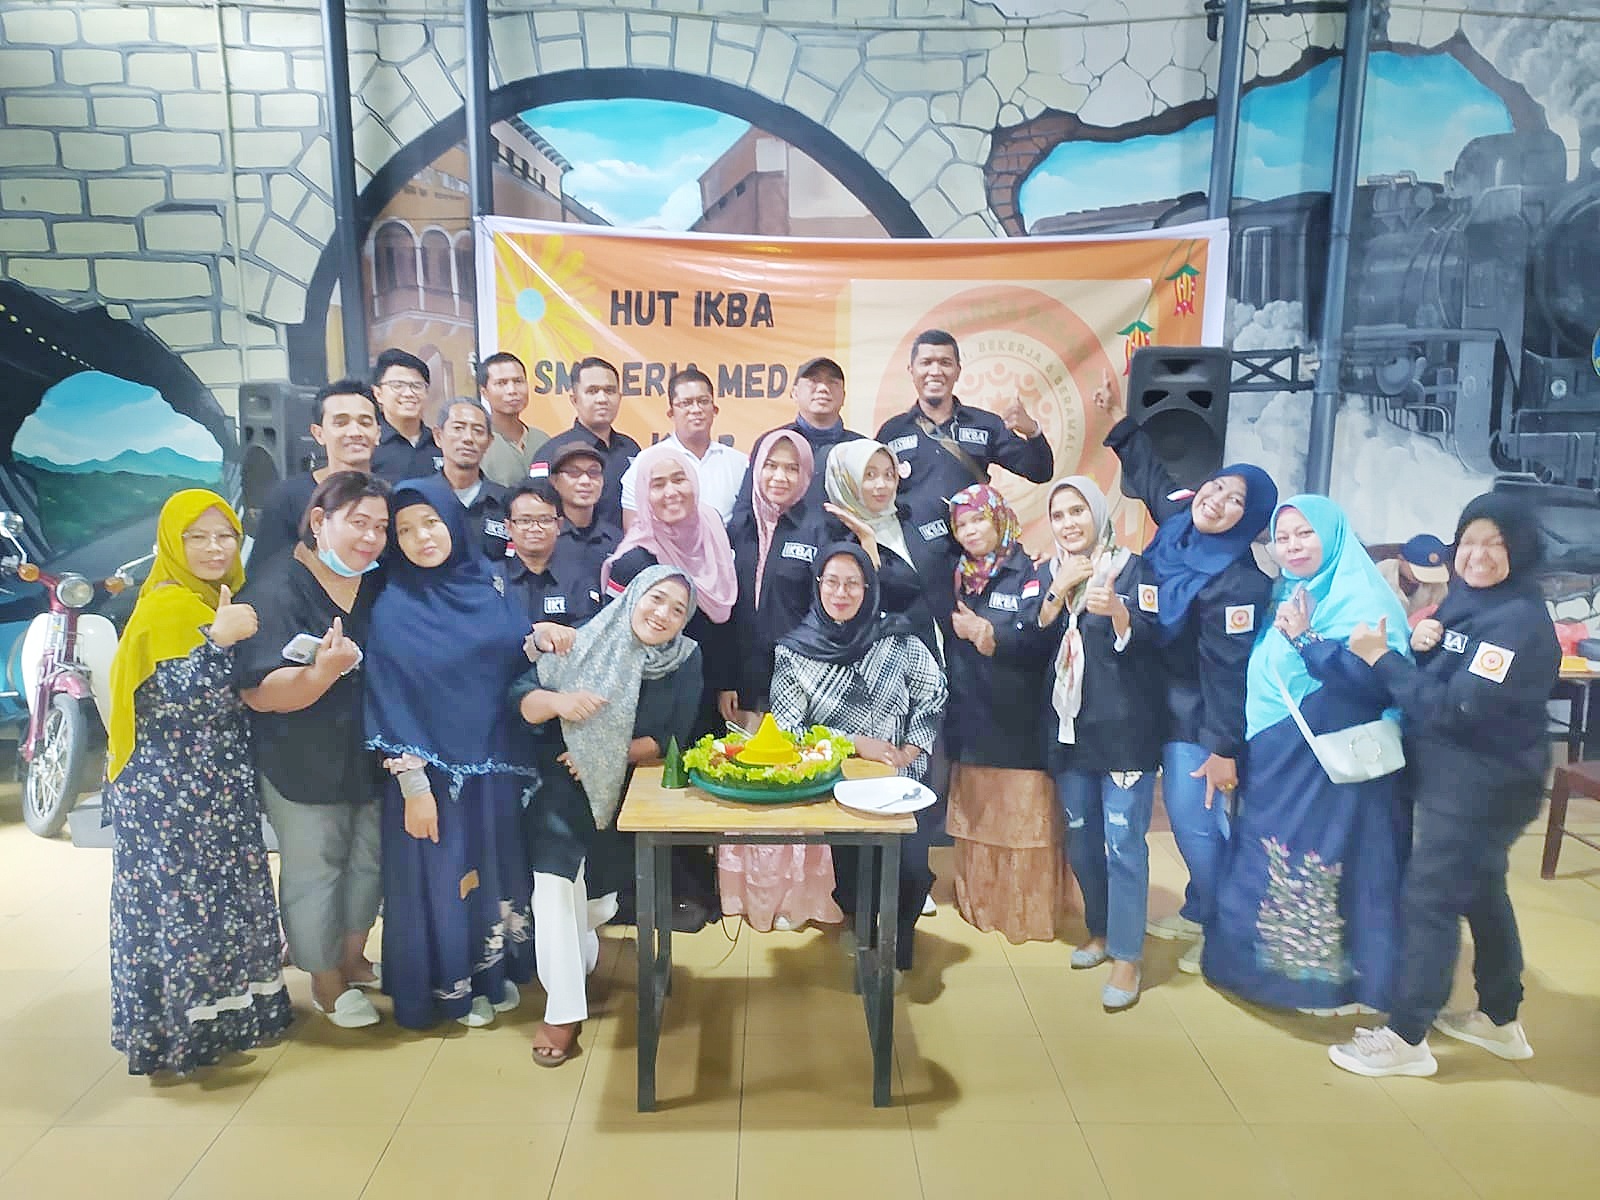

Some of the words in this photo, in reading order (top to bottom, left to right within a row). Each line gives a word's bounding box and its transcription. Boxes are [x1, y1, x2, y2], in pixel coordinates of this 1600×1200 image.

[610, 290, 679, 326] HUT
[694, 291, 774, 328] IKBA
[978, 339, 1042, 362] BEKERJA
[534, 360, 582, 395] SM
[622, 361, 698, 397] ER
[718, 363, 806, 398] MED
[784, 544, 815, 561] IKBA
